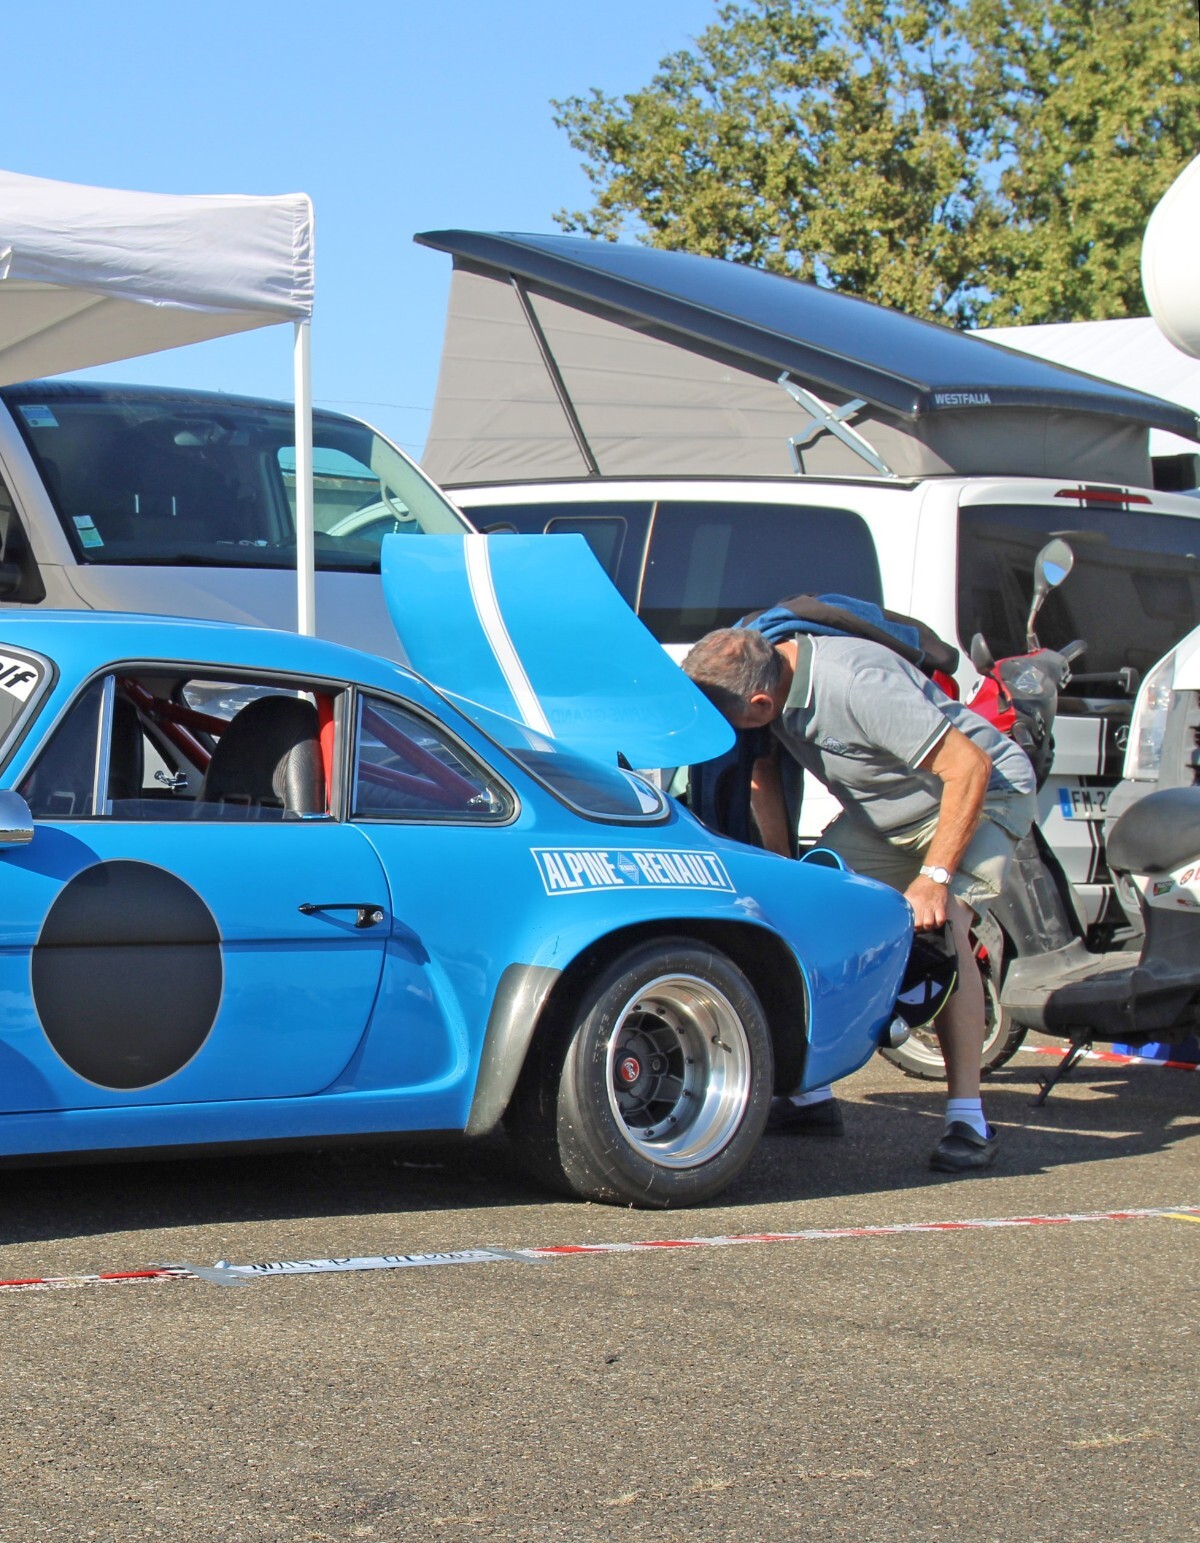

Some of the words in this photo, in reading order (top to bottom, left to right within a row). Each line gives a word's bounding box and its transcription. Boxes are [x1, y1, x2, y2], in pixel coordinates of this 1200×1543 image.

[934, 392, 992, 405] WESTFALIA
[1071, 790, 1109, 813] FM-2
[541, 851, 625, 890] ALPINE
[631, 852, 727, 887] RENAULT
